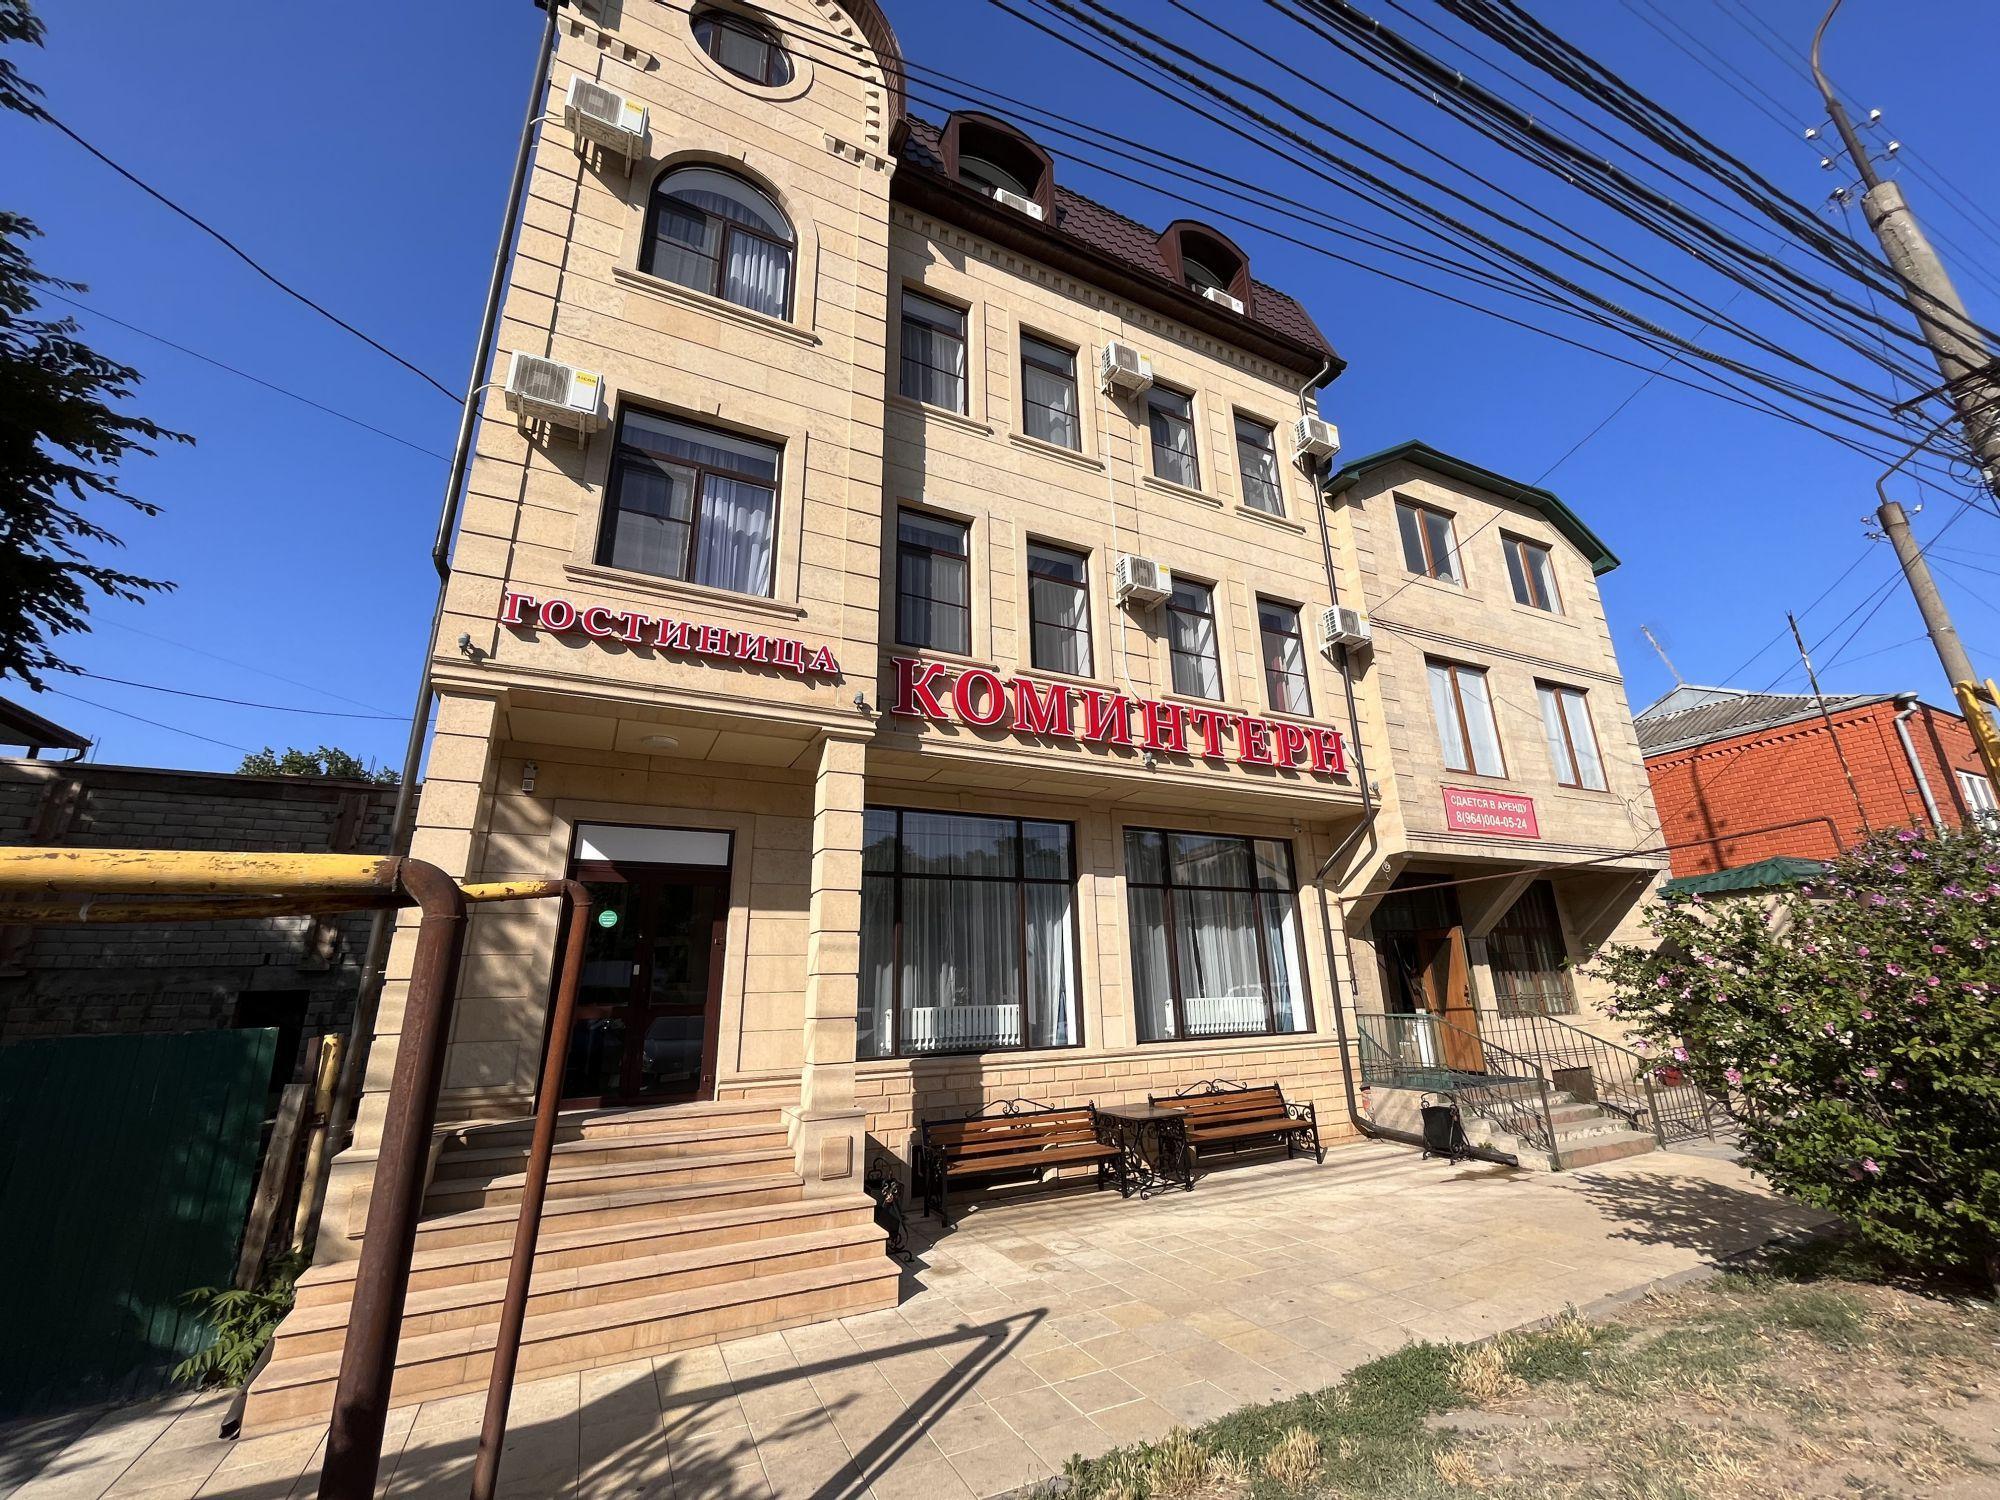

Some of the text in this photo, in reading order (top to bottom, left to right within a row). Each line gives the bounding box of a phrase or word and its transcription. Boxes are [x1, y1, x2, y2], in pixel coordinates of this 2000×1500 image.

[501, 590, 840, 673] ГОСТИНИЦА
[889, 656, 1350, 775] КОМИНТЕРН
[1450, 795, 1527, 813] СДАЕТСЯ В АРЕНДУ
[1456, 810, 1528, 829] 8(964)004-05-24
